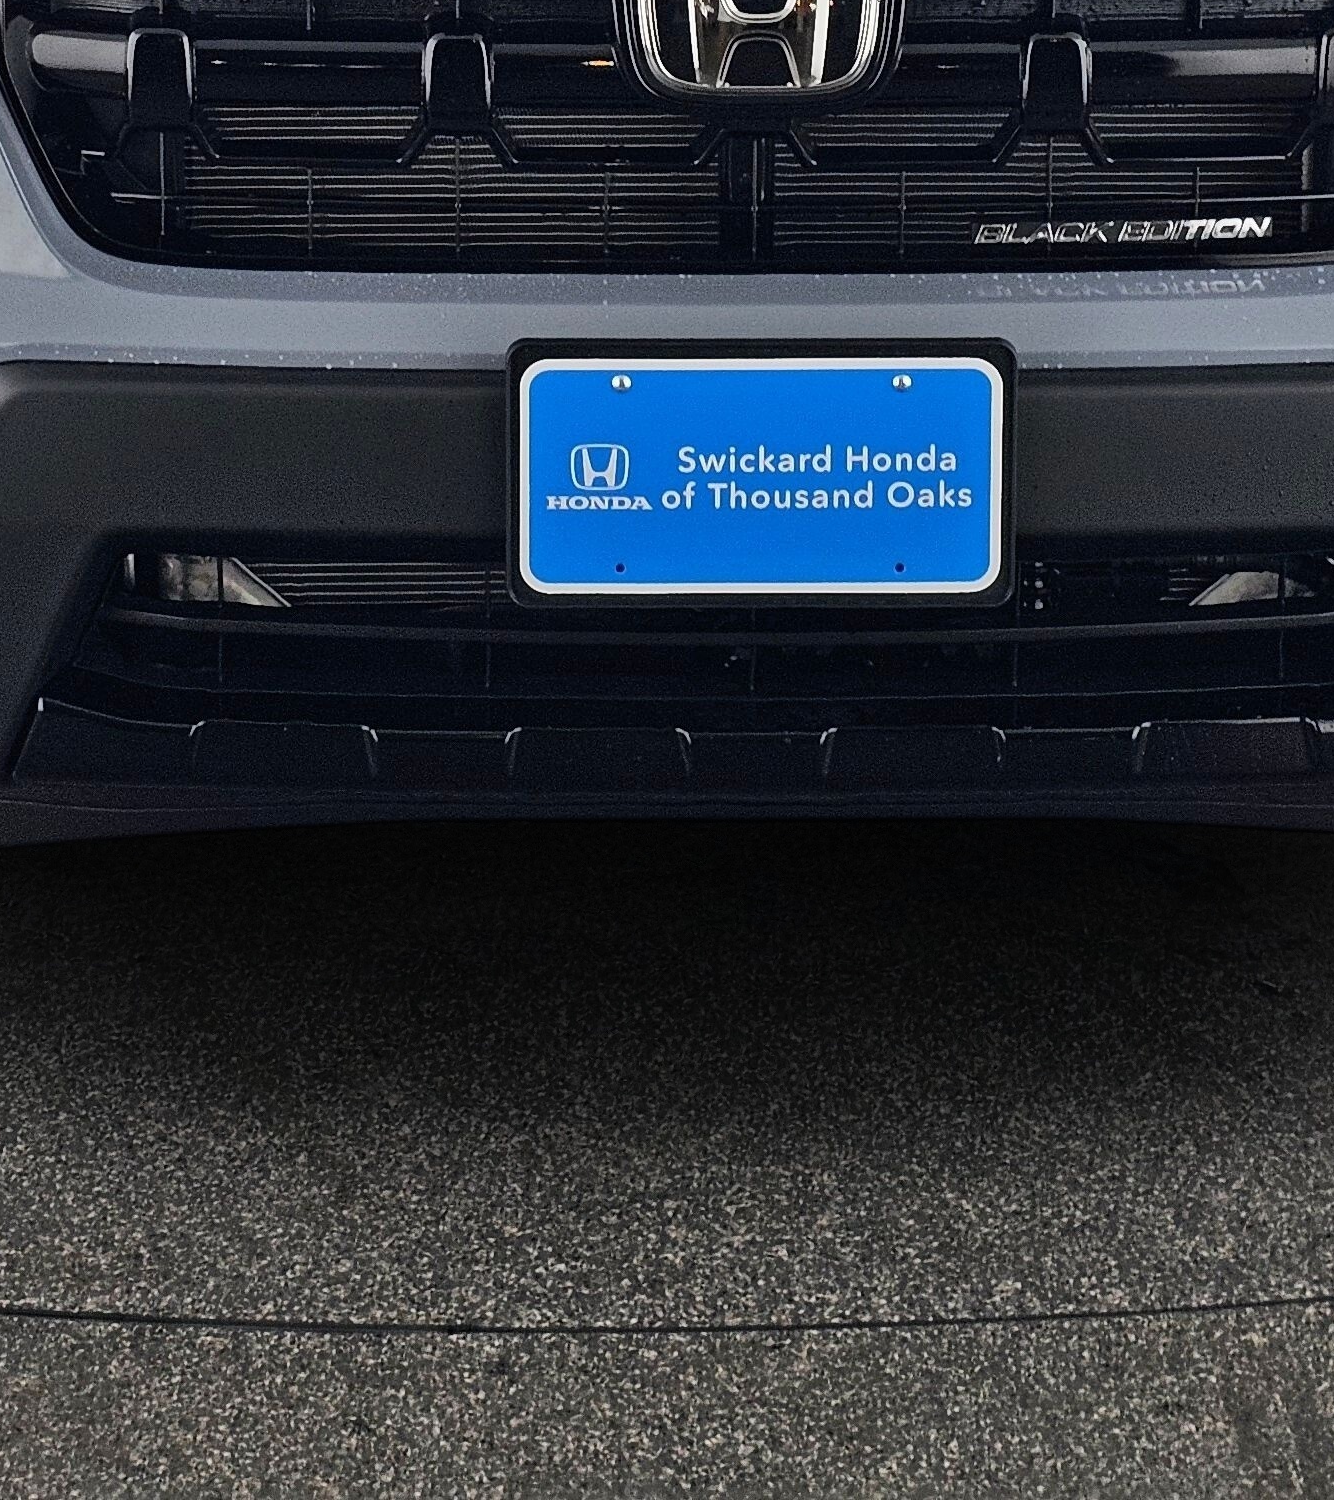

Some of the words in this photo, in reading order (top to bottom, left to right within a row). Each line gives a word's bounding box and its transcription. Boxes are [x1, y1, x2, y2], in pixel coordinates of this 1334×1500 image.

[973, 220, 1114, 244] BLACK
[1118, 216, 1272, 242] EDITION
[677, 444, 832, 474] Swickard
[845, 443, 958, 473] Honda
[546, 495, 653, 510] HONDA
[661, 481, 696, 510] of
[707, 480, 874, 510] Thousand
[886, 479, 973, 509] Oaks
